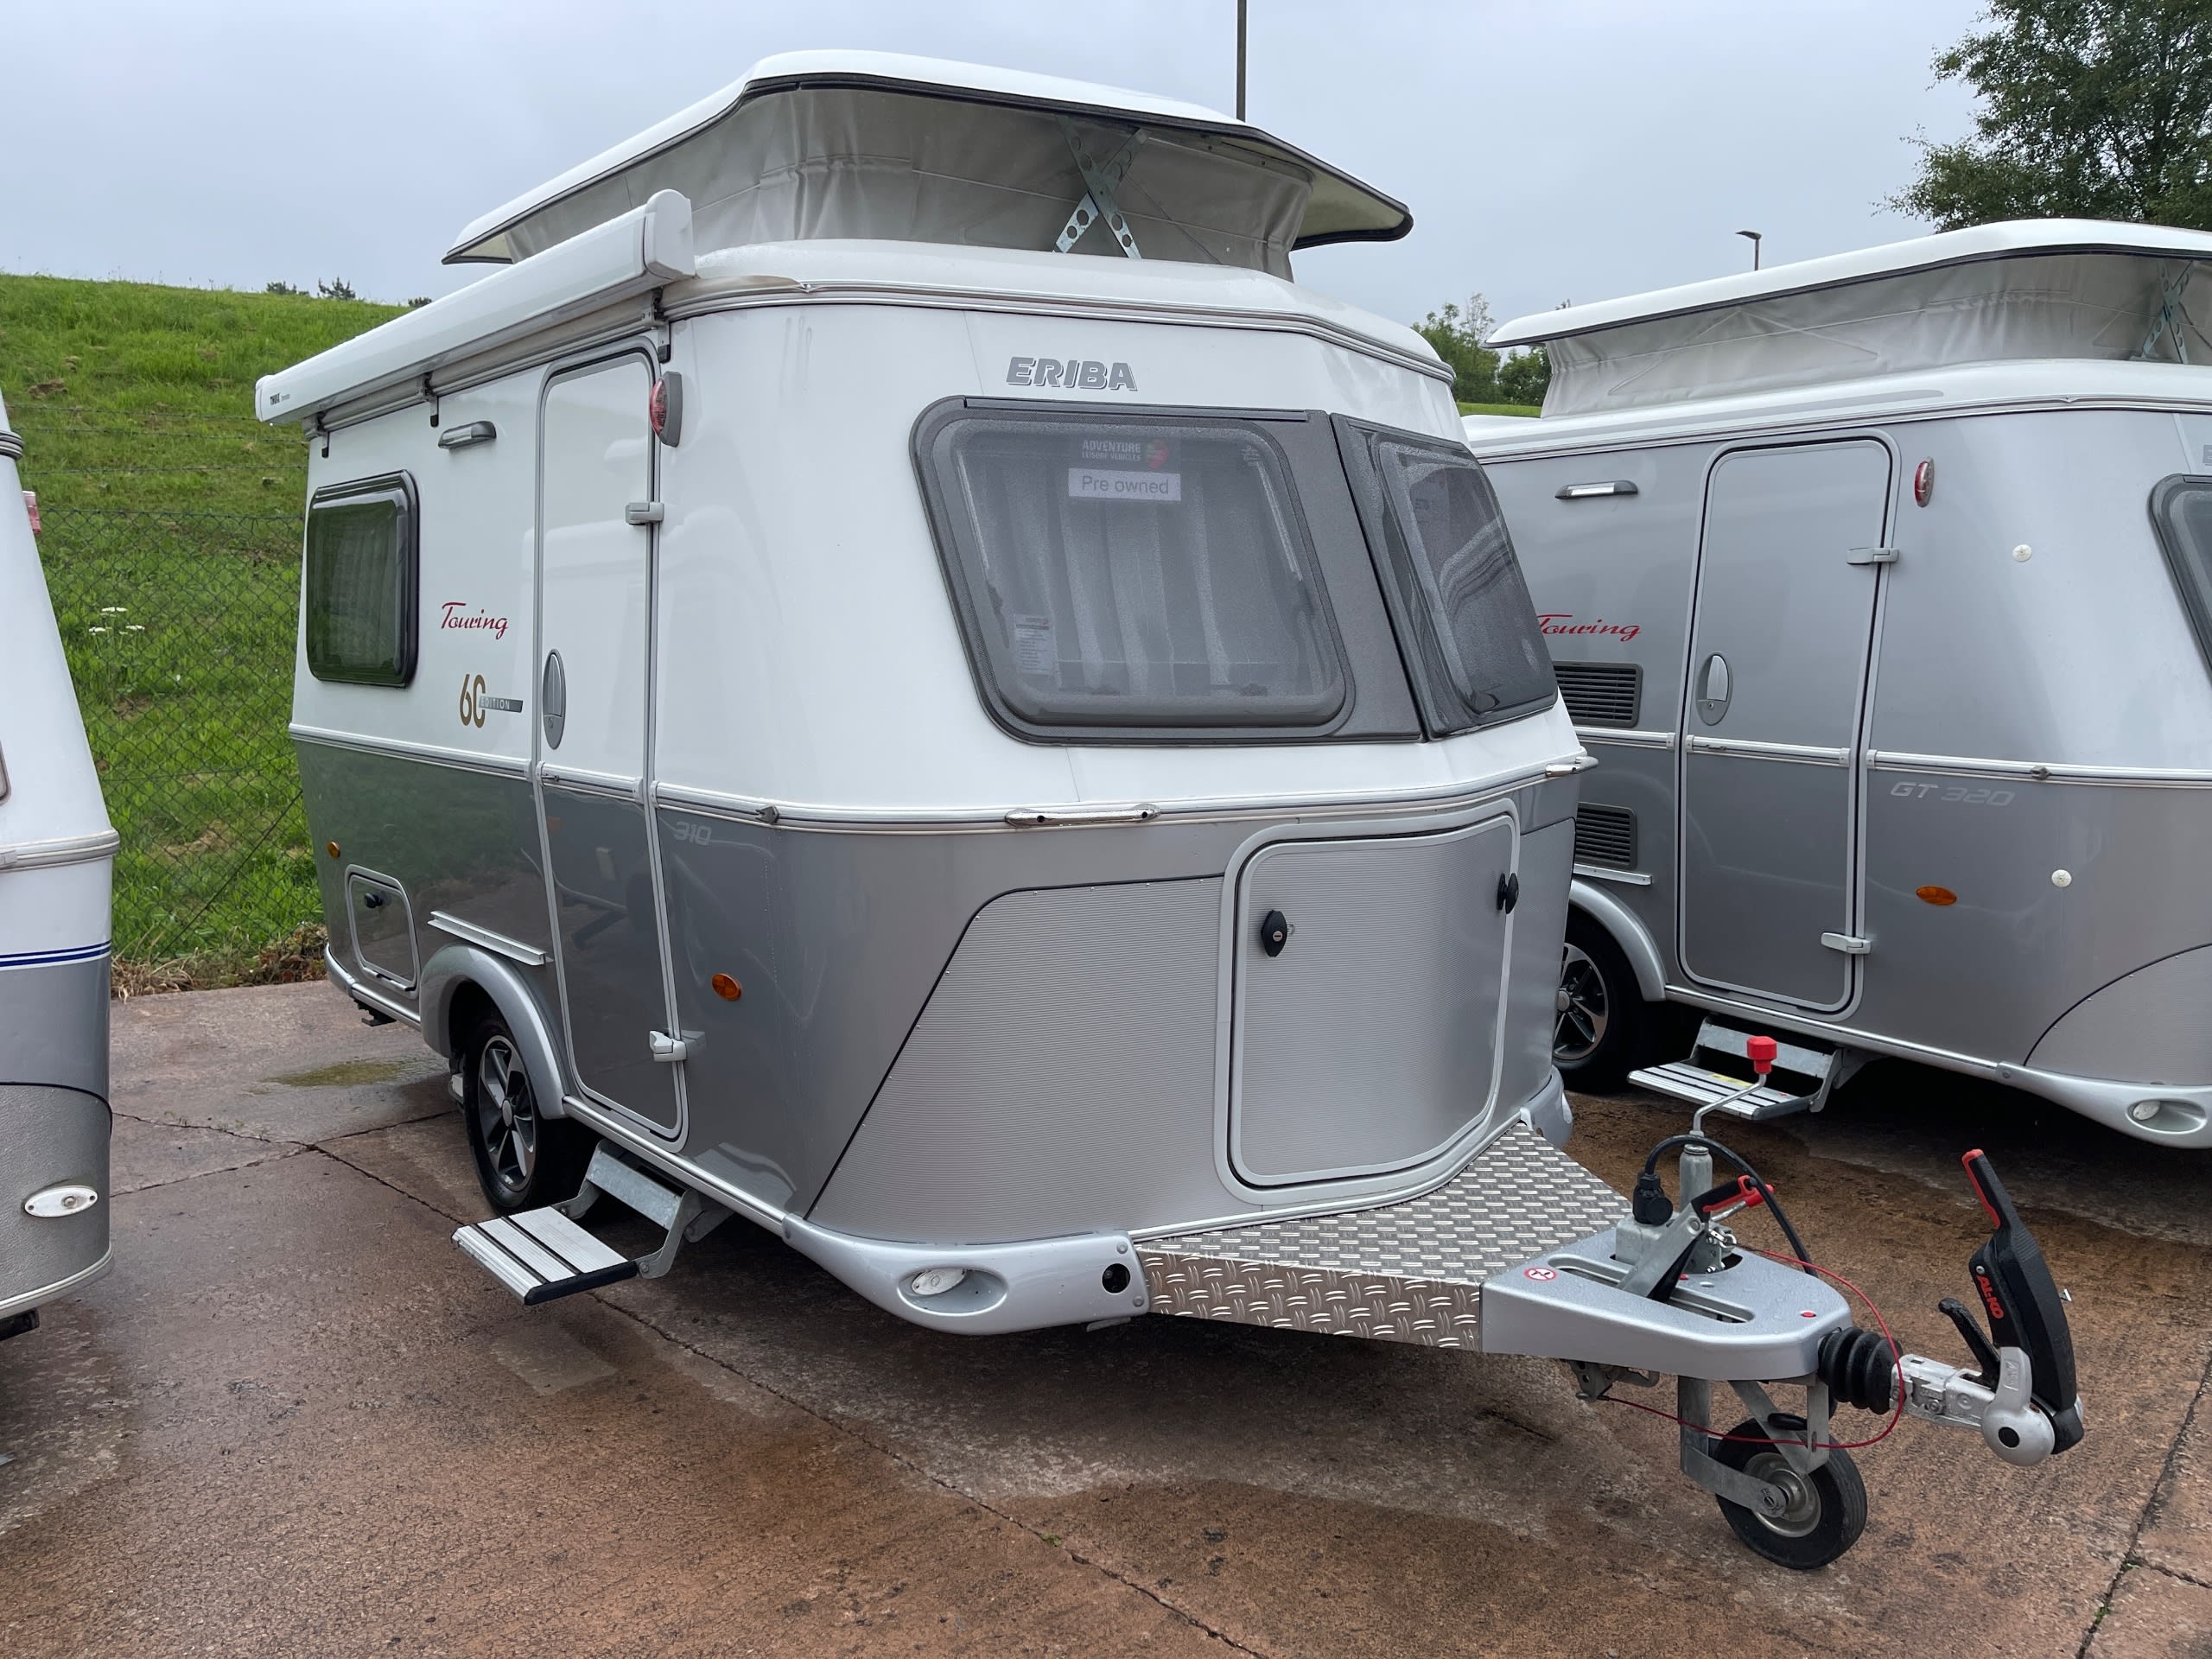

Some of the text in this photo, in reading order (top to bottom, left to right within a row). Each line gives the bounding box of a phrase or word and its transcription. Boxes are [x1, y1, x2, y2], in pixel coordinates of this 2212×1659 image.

[1006, 356, 1138, 391] ERIBA
[1082, 440, 1141, 454] ADVENTURE
[1082, 475, 1169, 494] Pre owned
[441, 601, 509, 640] Touring
[1536, 613, 1641, 642] Touring
[459, 673, 510, 728] 60 EDITION
[1890, 780, 2016, 807] GT 320
[673, 821, 712, 846] 310
[1976, 1274, 2005, 1319] AL-KO
